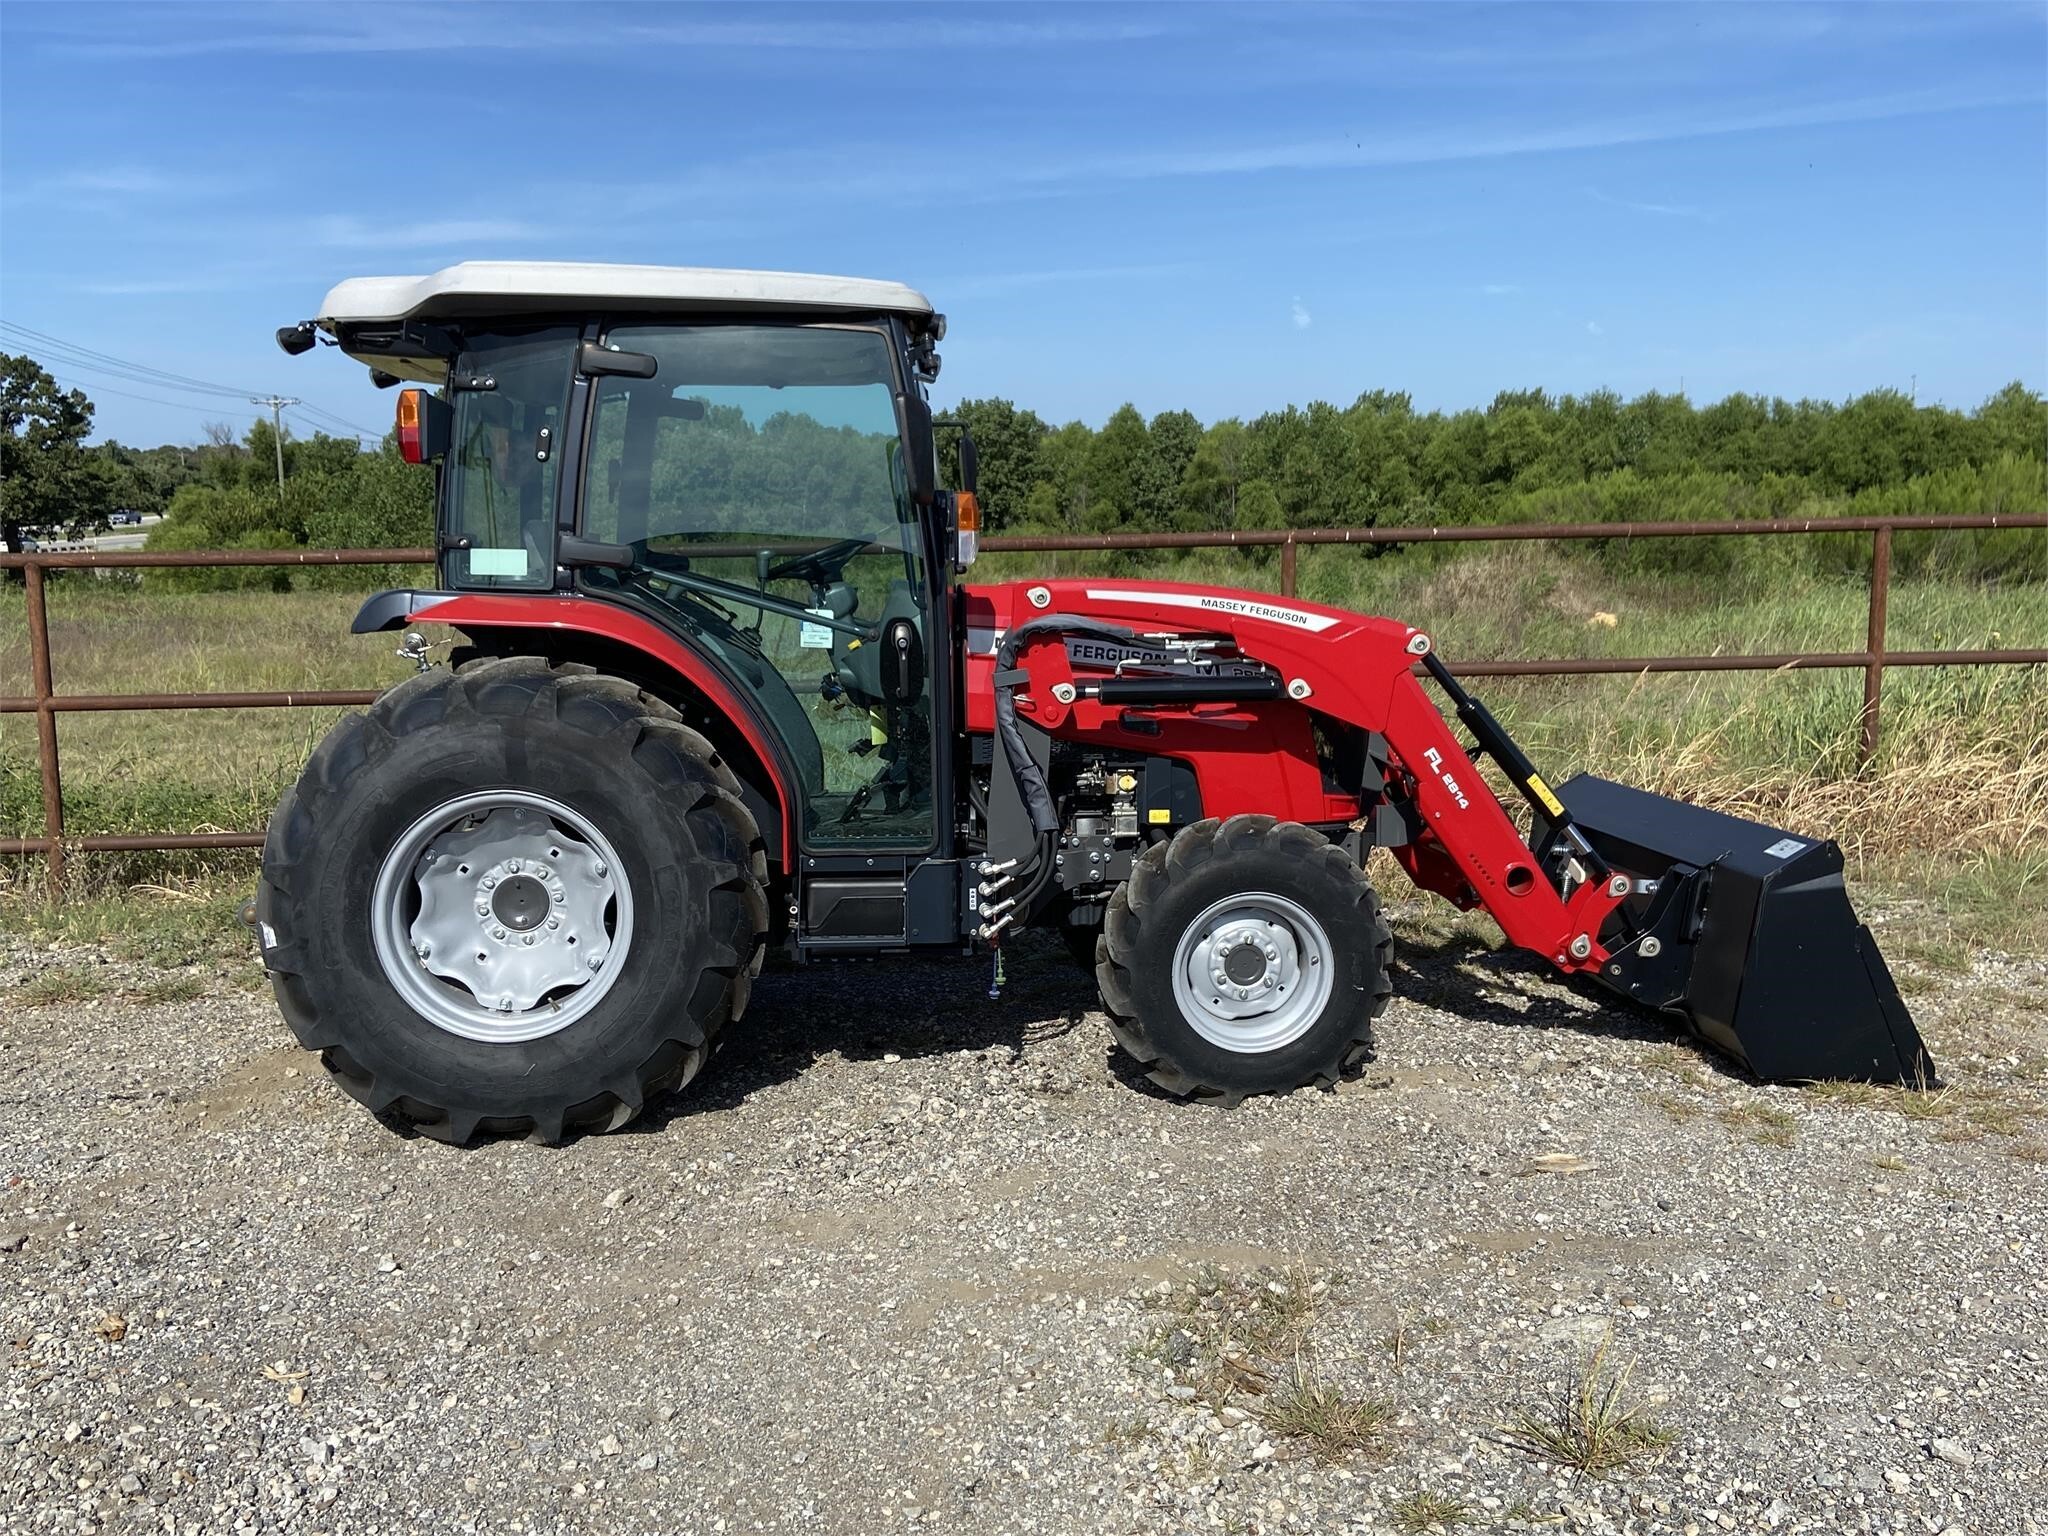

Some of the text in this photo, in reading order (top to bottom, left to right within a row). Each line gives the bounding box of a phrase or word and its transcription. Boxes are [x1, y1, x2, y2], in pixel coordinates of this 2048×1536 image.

[1201, 598, 1308, 625] MASSEY FERGUSON
[1423, 746, 1469, 810] FL 2814
